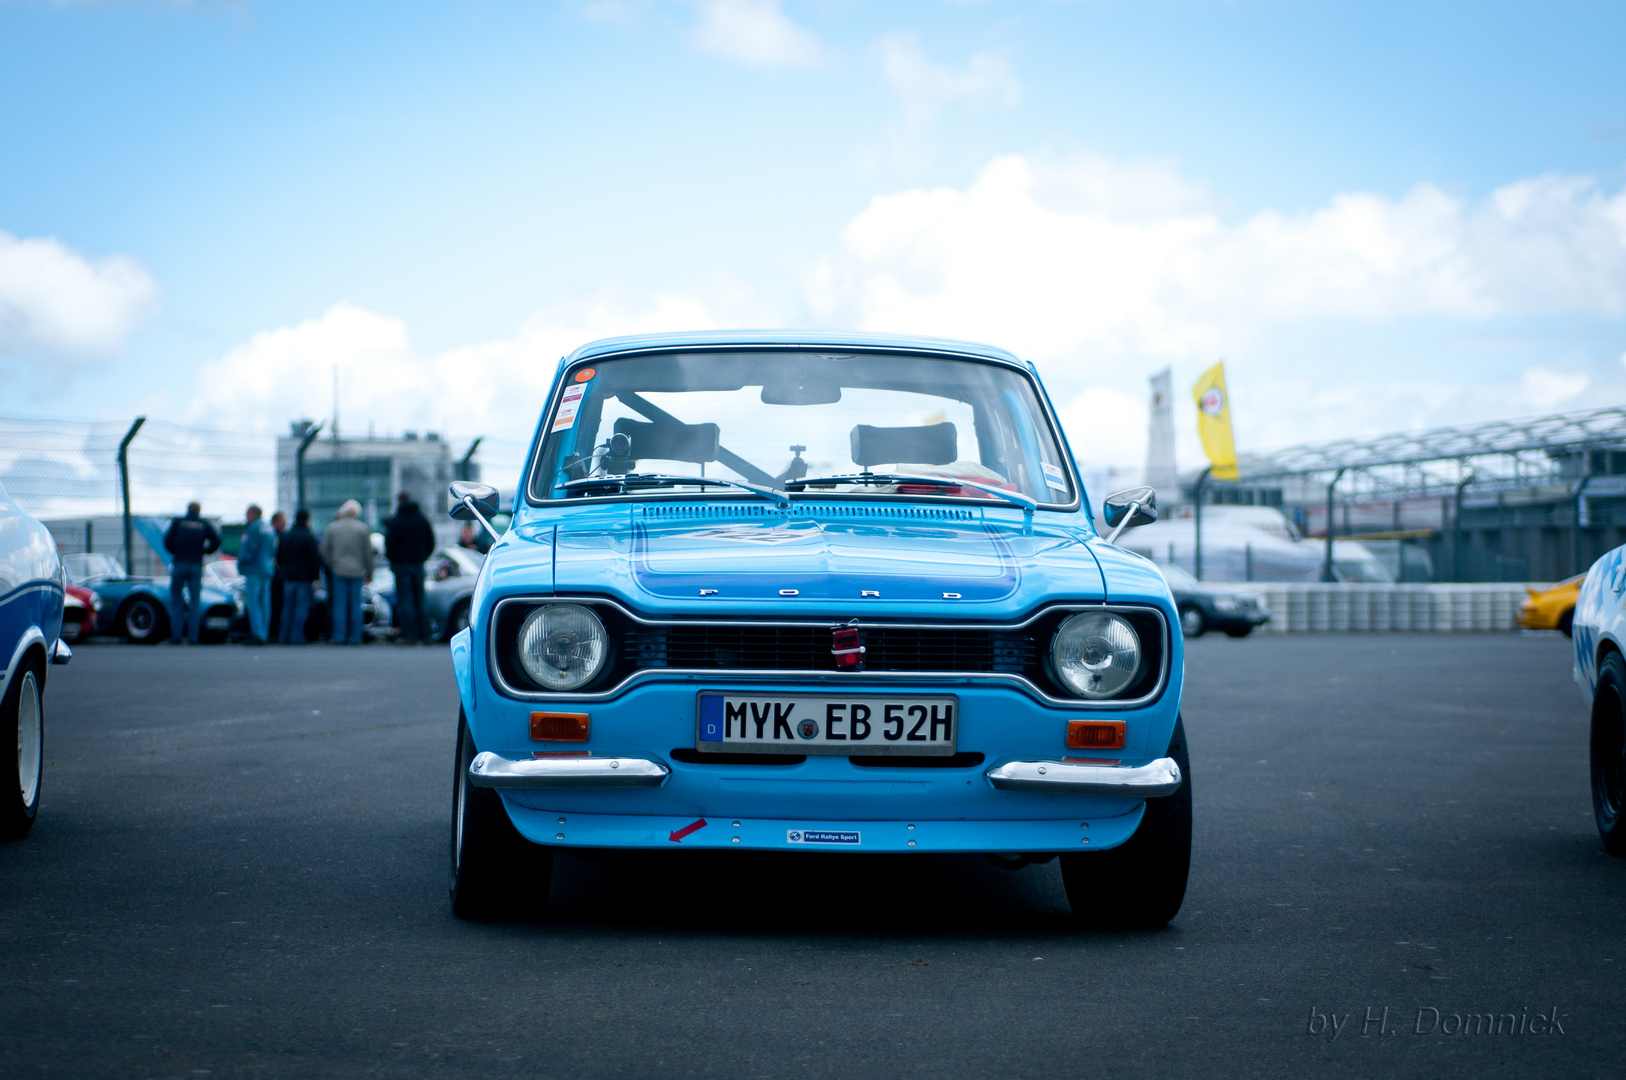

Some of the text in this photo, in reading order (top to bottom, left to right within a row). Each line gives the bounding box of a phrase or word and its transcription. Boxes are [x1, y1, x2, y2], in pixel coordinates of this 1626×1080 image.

[699, 588, 962, 600] FORD
[725, 701, 953, 742] MYK EB 52H
[707, 723, 716, 735] D
[820, 833, 839, 841] Rallye
